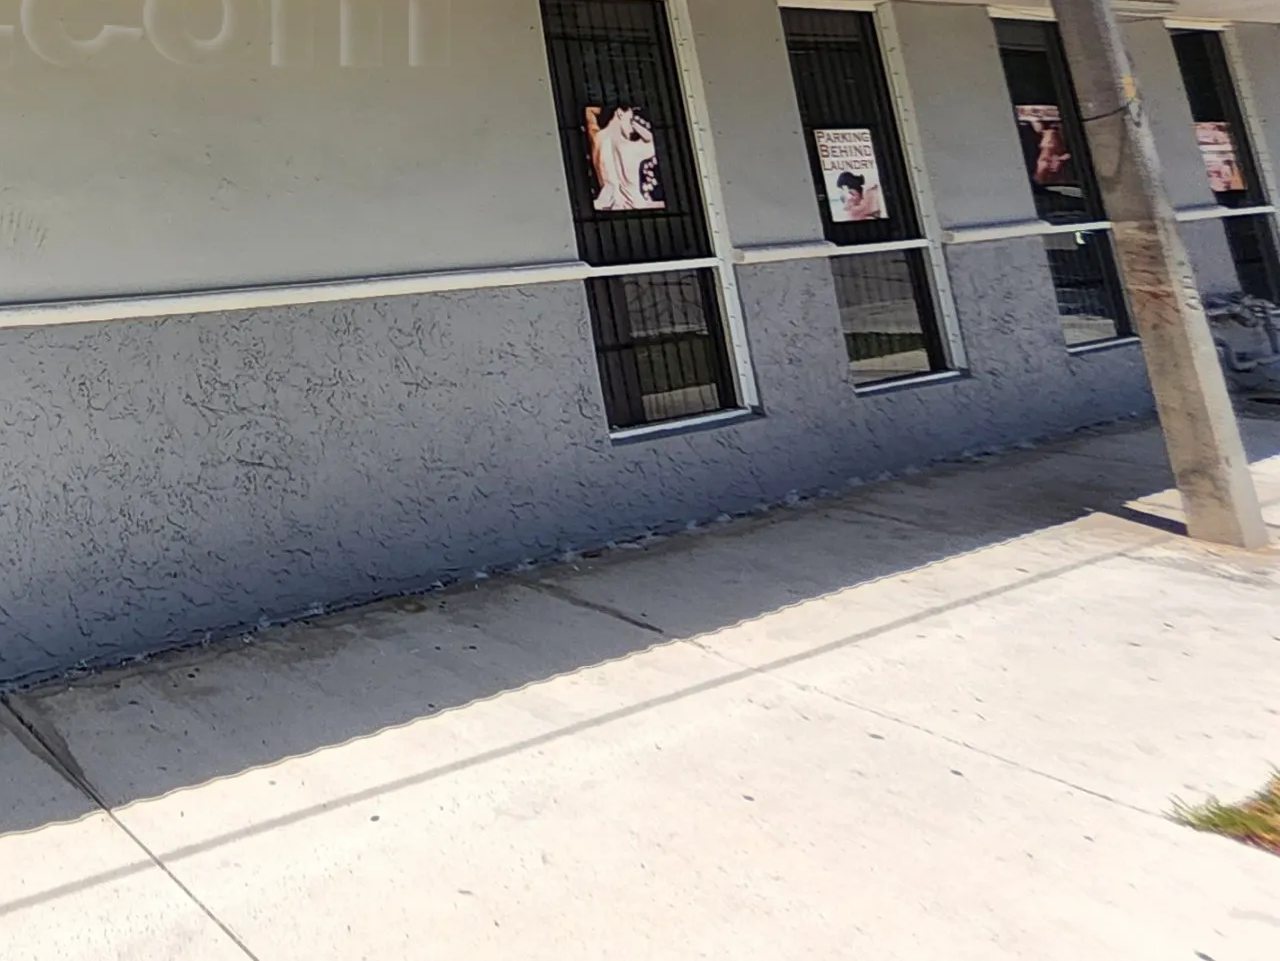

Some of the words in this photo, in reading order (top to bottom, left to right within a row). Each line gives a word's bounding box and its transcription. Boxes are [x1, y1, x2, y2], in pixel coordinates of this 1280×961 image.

[815, 131, 870, 143] PARKING
[819, 144, 872, 158] BEHIND
[822, 160, 874, 171] LAUNDRY
